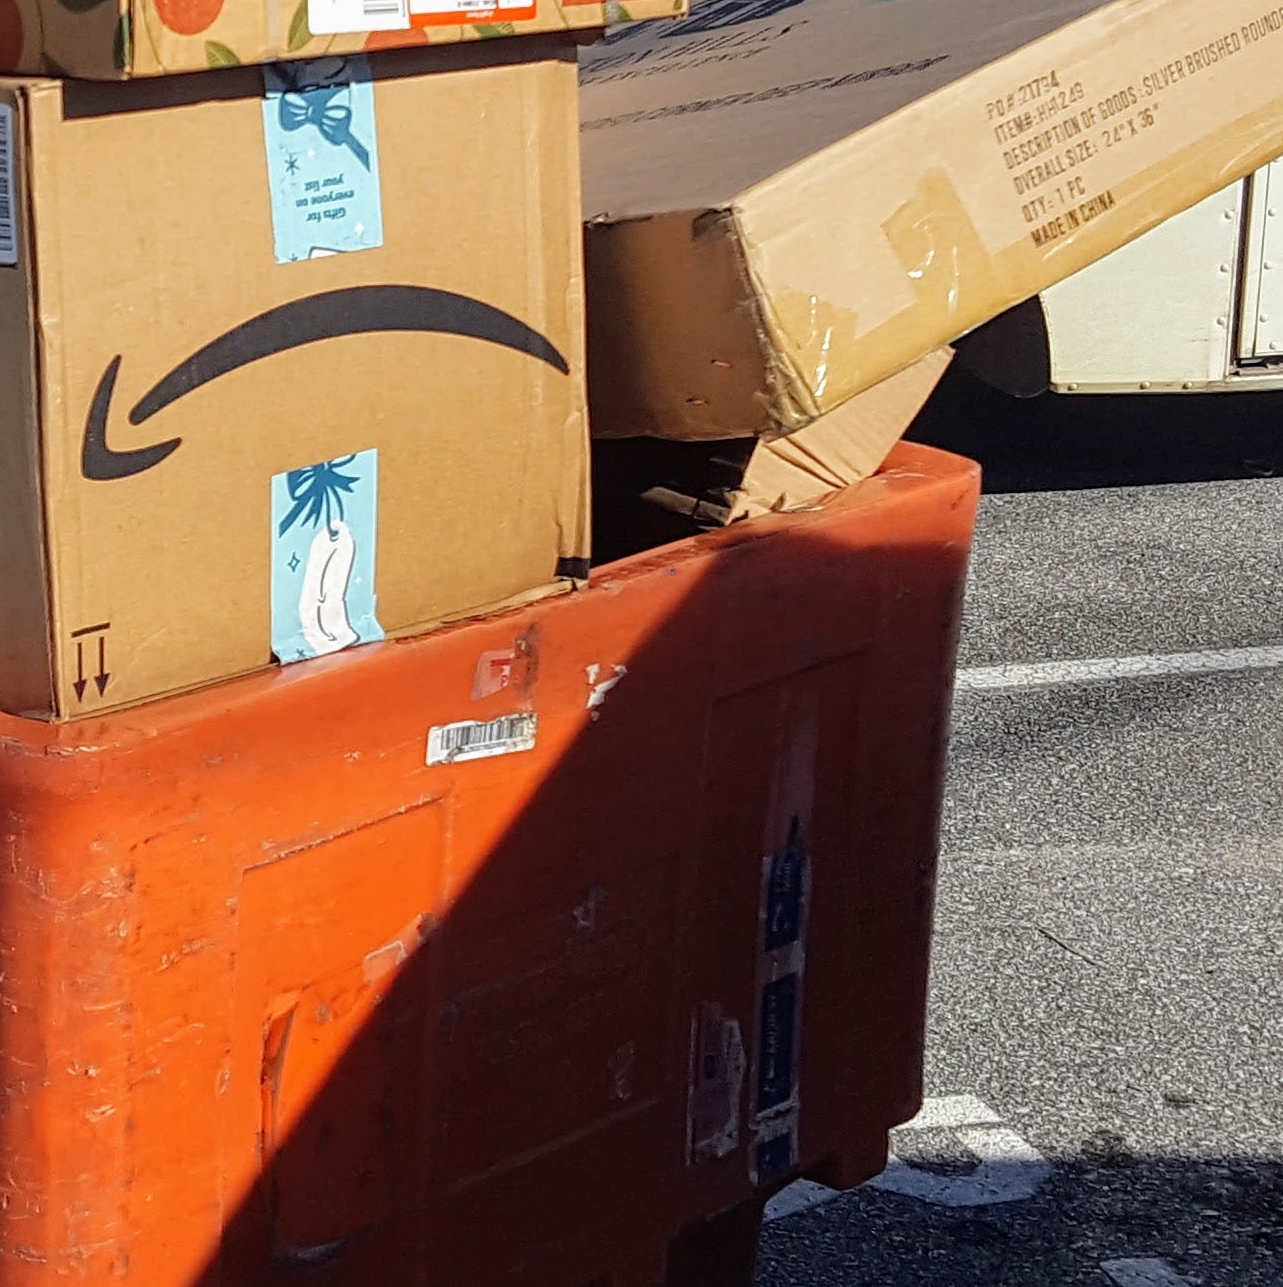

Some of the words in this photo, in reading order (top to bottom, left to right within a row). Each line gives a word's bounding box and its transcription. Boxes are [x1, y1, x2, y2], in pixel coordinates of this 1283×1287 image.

[1003, 116, 1082, 169] DESCRIPTION
[1081, 106, 1097, 129] OF
[1142, 59, 1186, 97] SILVER
[1185, 32, 1241, 76] BRUSHED
[1013, 155, 1067, 196] OVERALL
[1066, 139, 1099, 168] SIZE:
[1128, 118, 1139, 137] X
[303, 179, 320, 192] list
[322, 173, 345, 188] your
[295, 197, 309, 209] on
[310, 189, 355, 206] everyone
[1021, 195, 1054, 224] QTY:
[1056, 187, 1066, 205] 1
[1067, 176, 1086, 200] PC
[306, 211, 322, 223] for
[322, 207, 347, 220] Gifts
[1030, 216, 1066, 249] MADE
[1067, 210, 1081, 231] IN
[1080, 189, 1117, 222] CHINA
